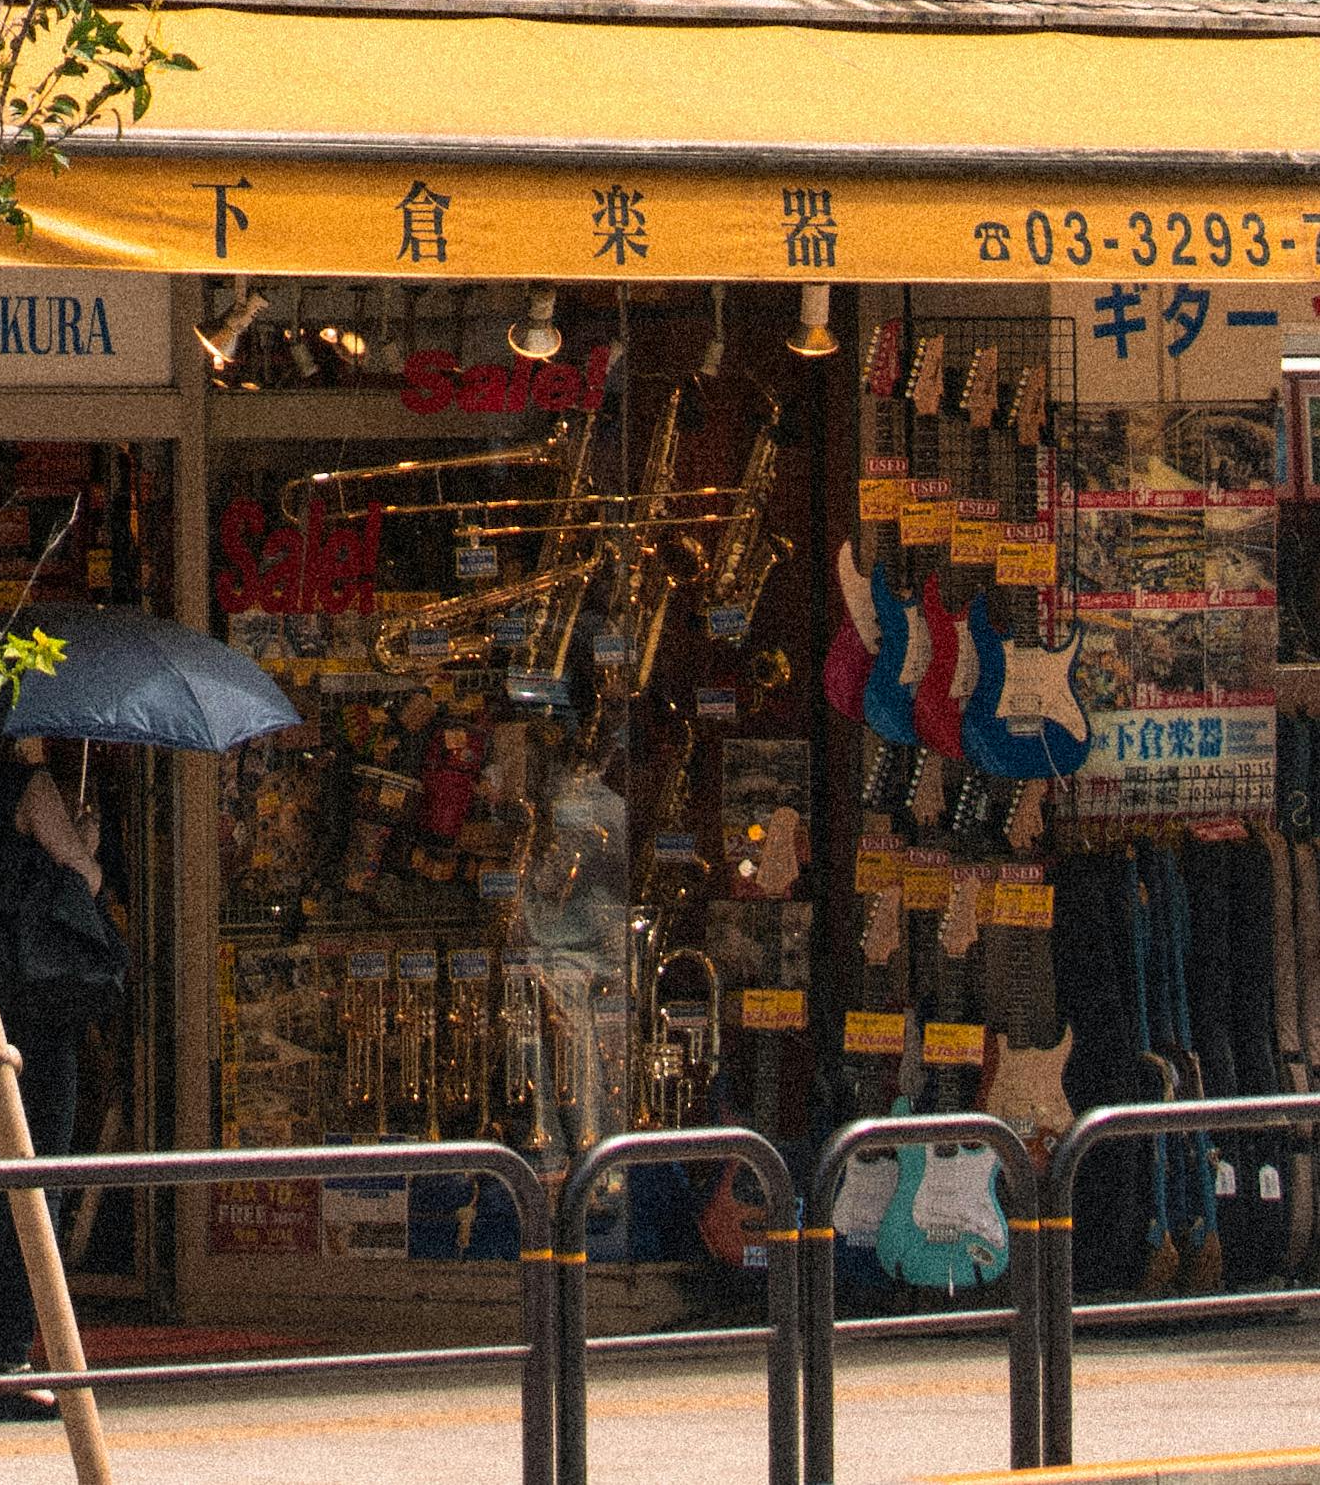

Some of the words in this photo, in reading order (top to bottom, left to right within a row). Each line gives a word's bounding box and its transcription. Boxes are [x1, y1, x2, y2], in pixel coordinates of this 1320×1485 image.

[1093, 283, 1279, 360] ギター
[400, 346, 613, 415] Sale!
[216, 497, 382, 617] Sale!
